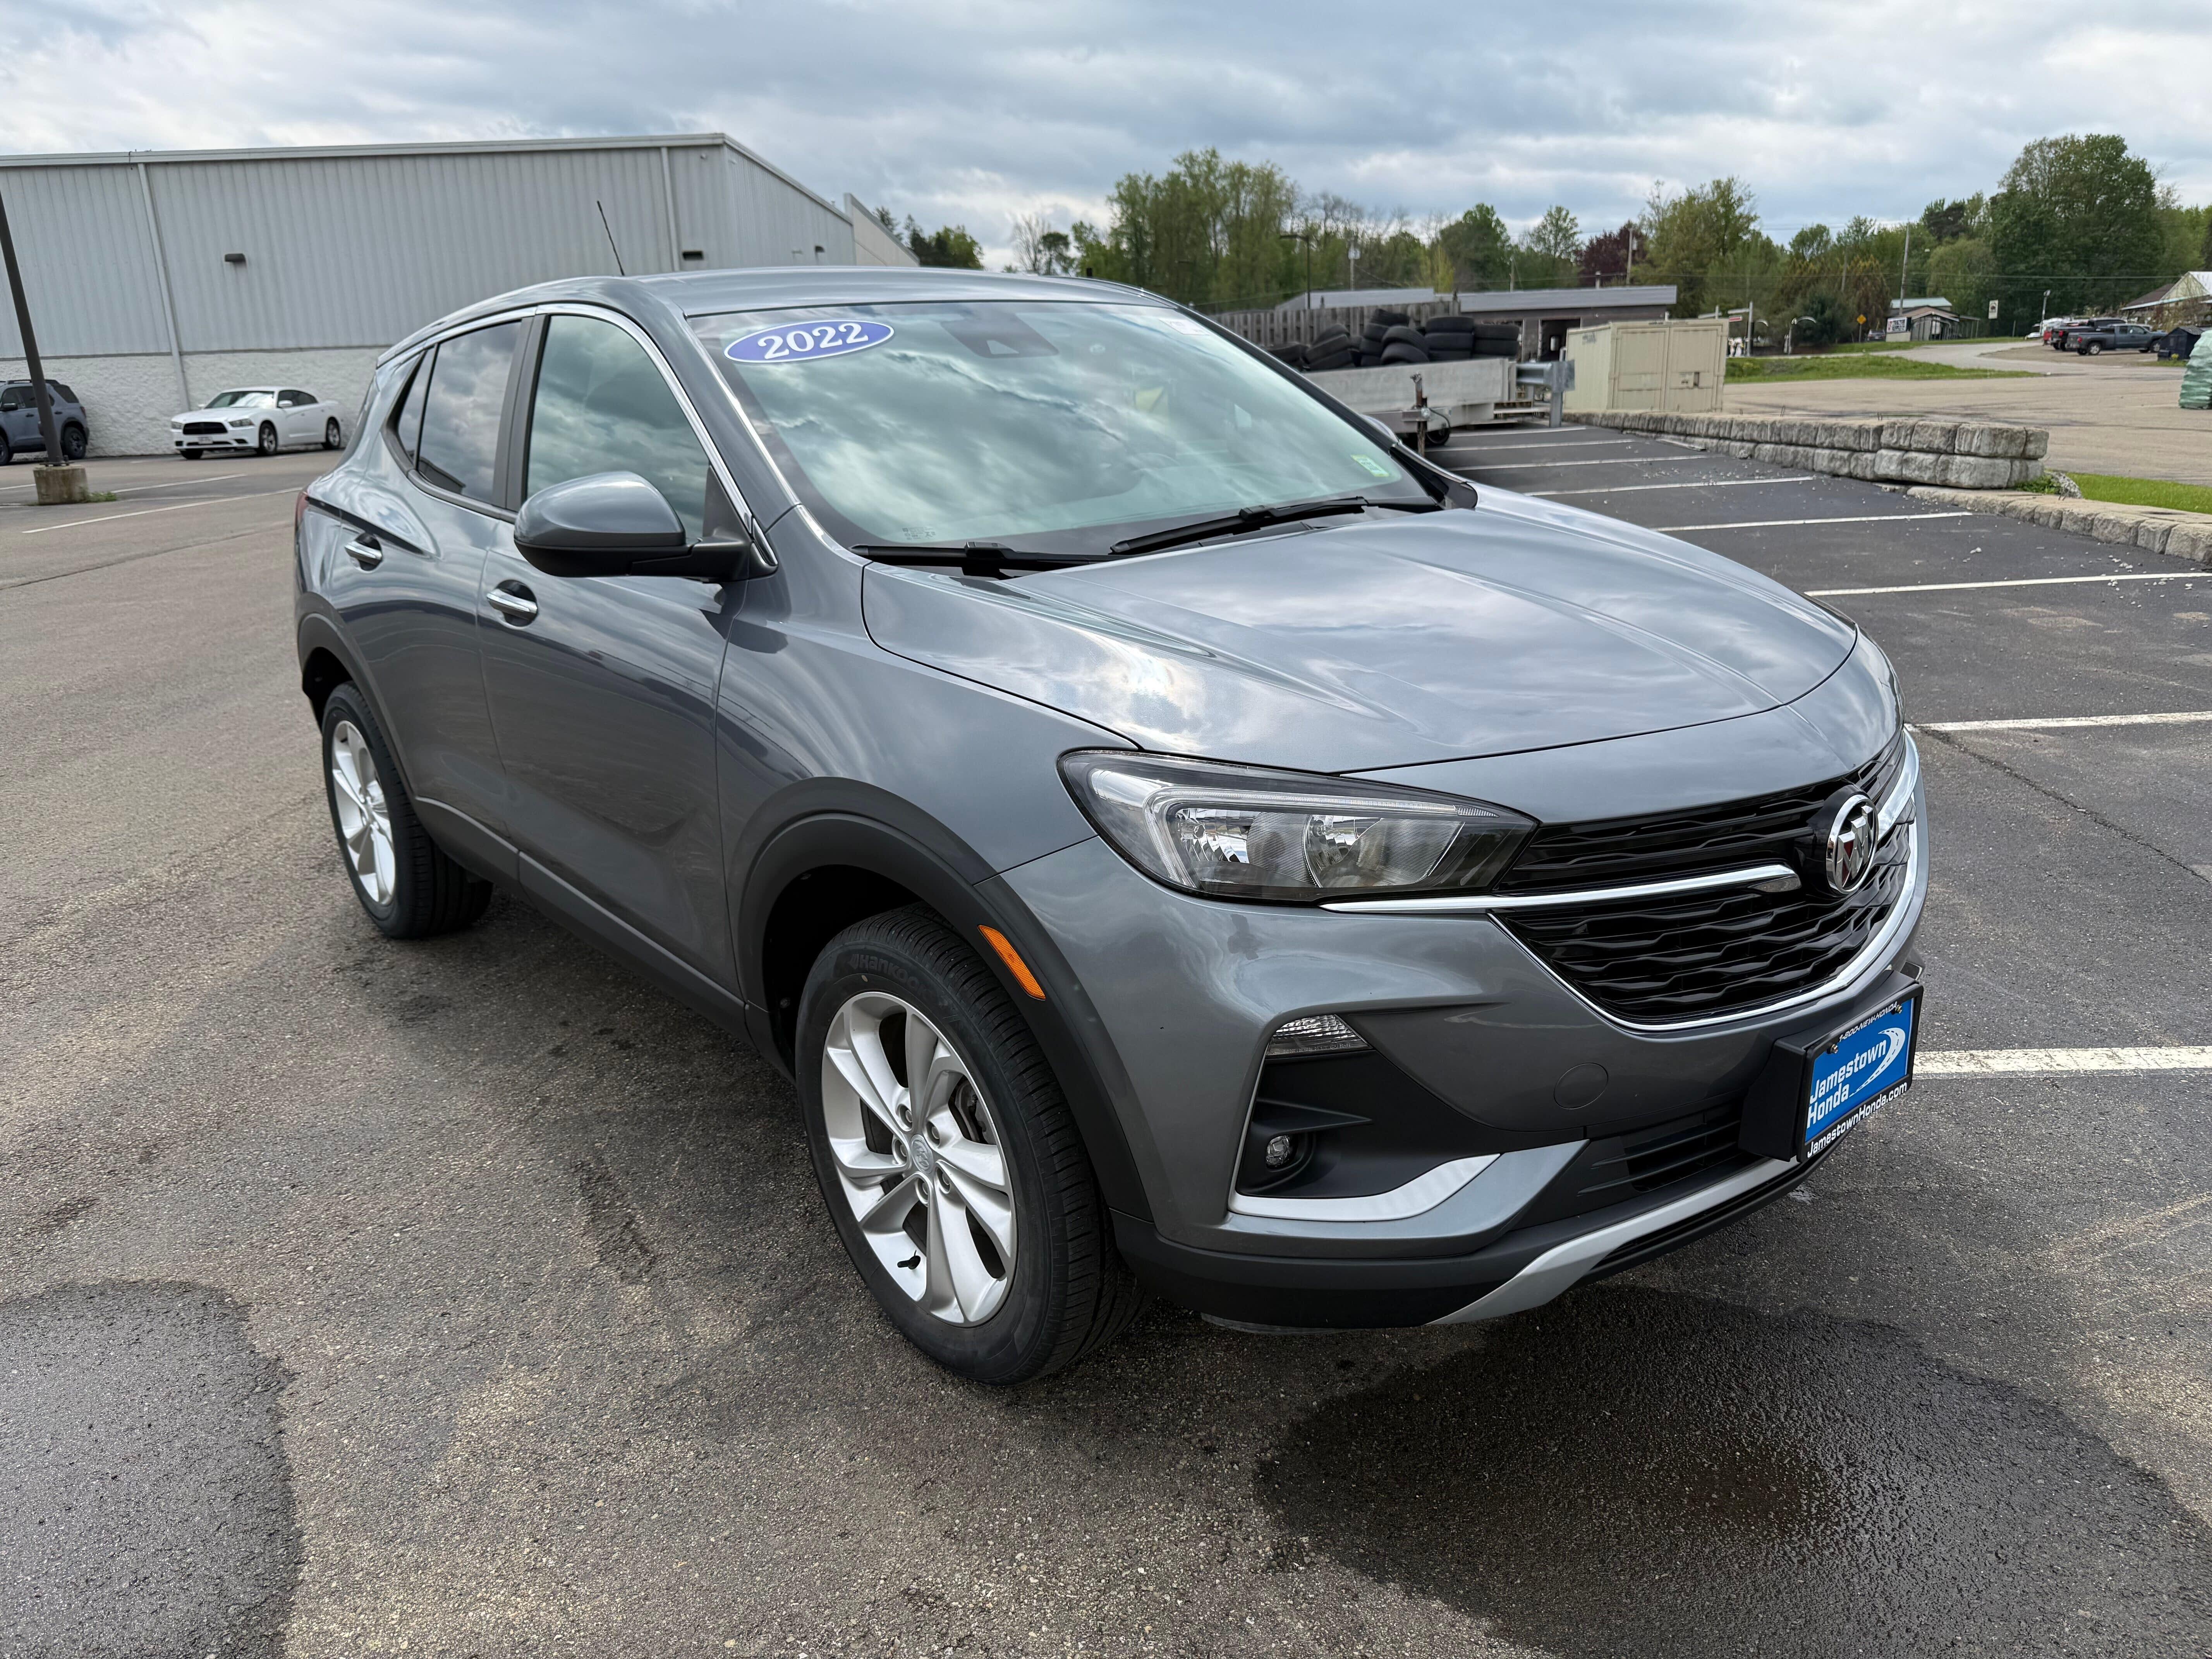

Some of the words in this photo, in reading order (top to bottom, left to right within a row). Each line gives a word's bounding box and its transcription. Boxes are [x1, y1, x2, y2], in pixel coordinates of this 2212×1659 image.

[757, 323, 869, 359] 2022
[1839, 1001, 1897, 1042] 1-800-NEW-HONDA
[1810, 1040, 1886, 1104] Jamestown
[1807, 1084, 1849, 1128] Honda
[1807, 1082, 1907, 1158] JamestownHonda.com
